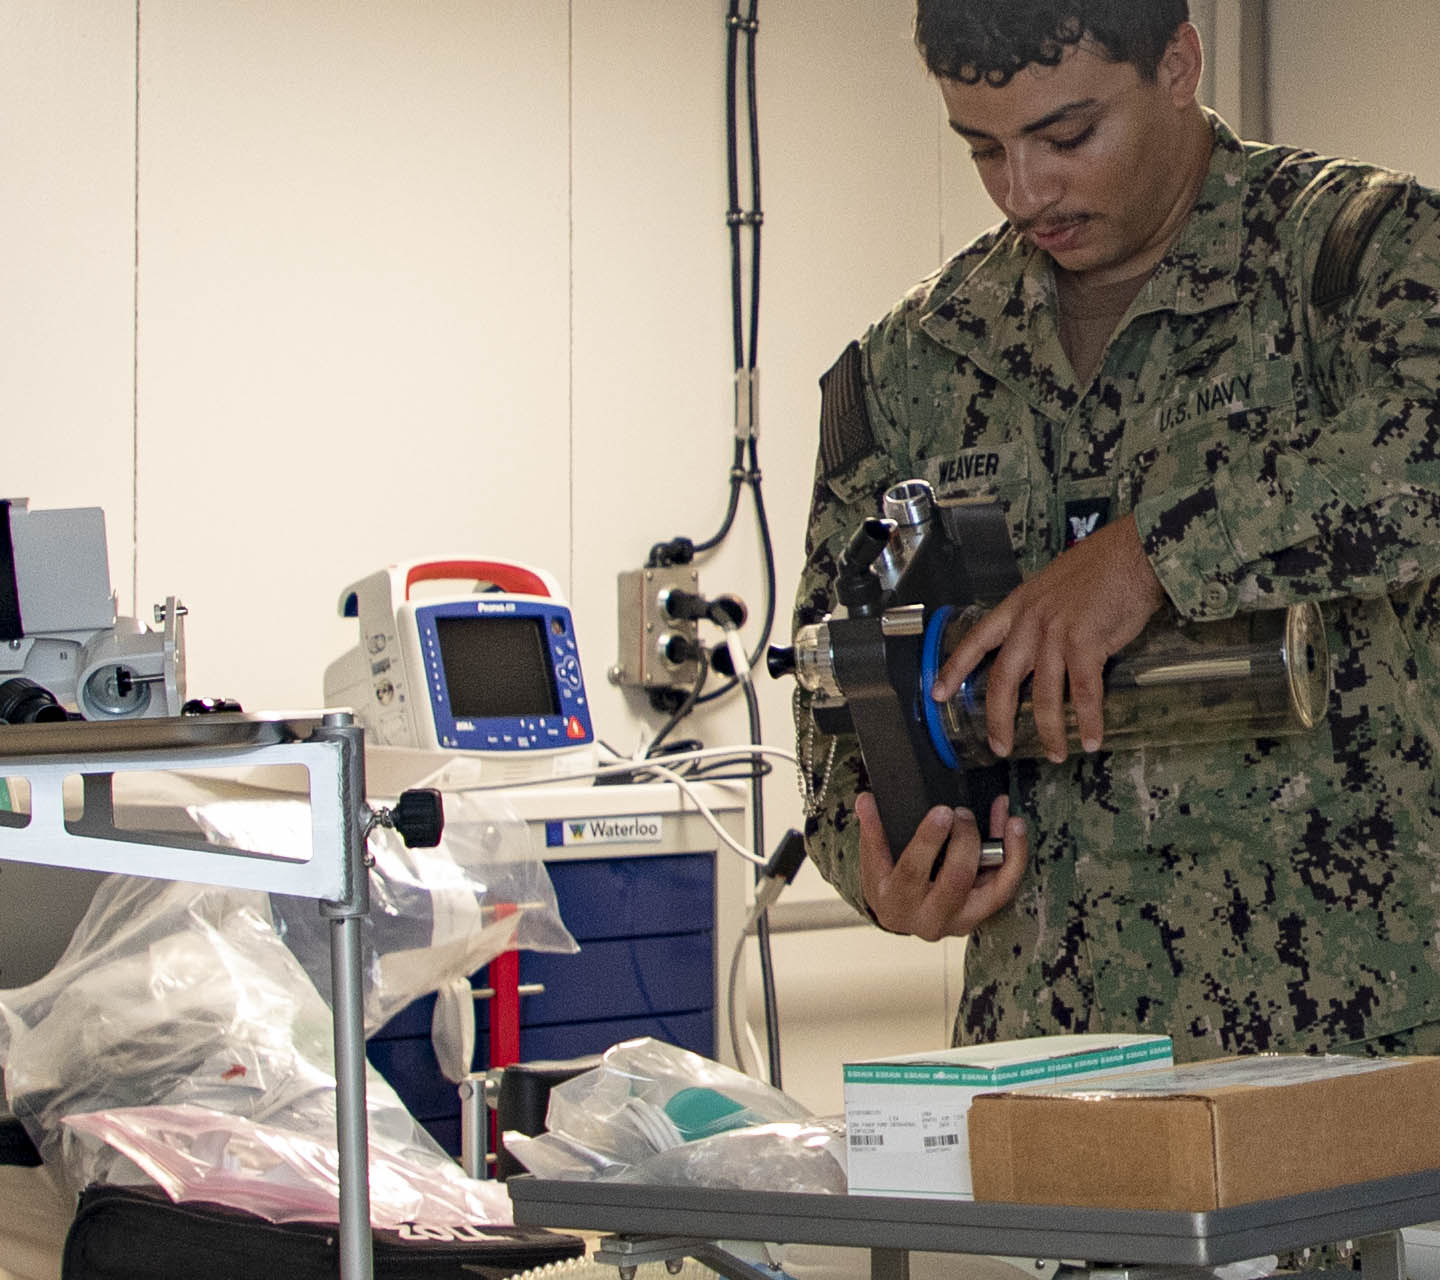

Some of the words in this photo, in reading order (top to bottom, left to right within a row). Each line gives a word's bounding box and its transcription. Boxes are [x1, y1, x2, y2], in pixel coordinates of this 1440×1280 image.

[1159, 408, 1191, 434] U.S.
[1196, 373, 1254, 416] NAVY
[937, 452, 1000, 486] WEAVER
[590, 817, 658, 838] Waterloo
